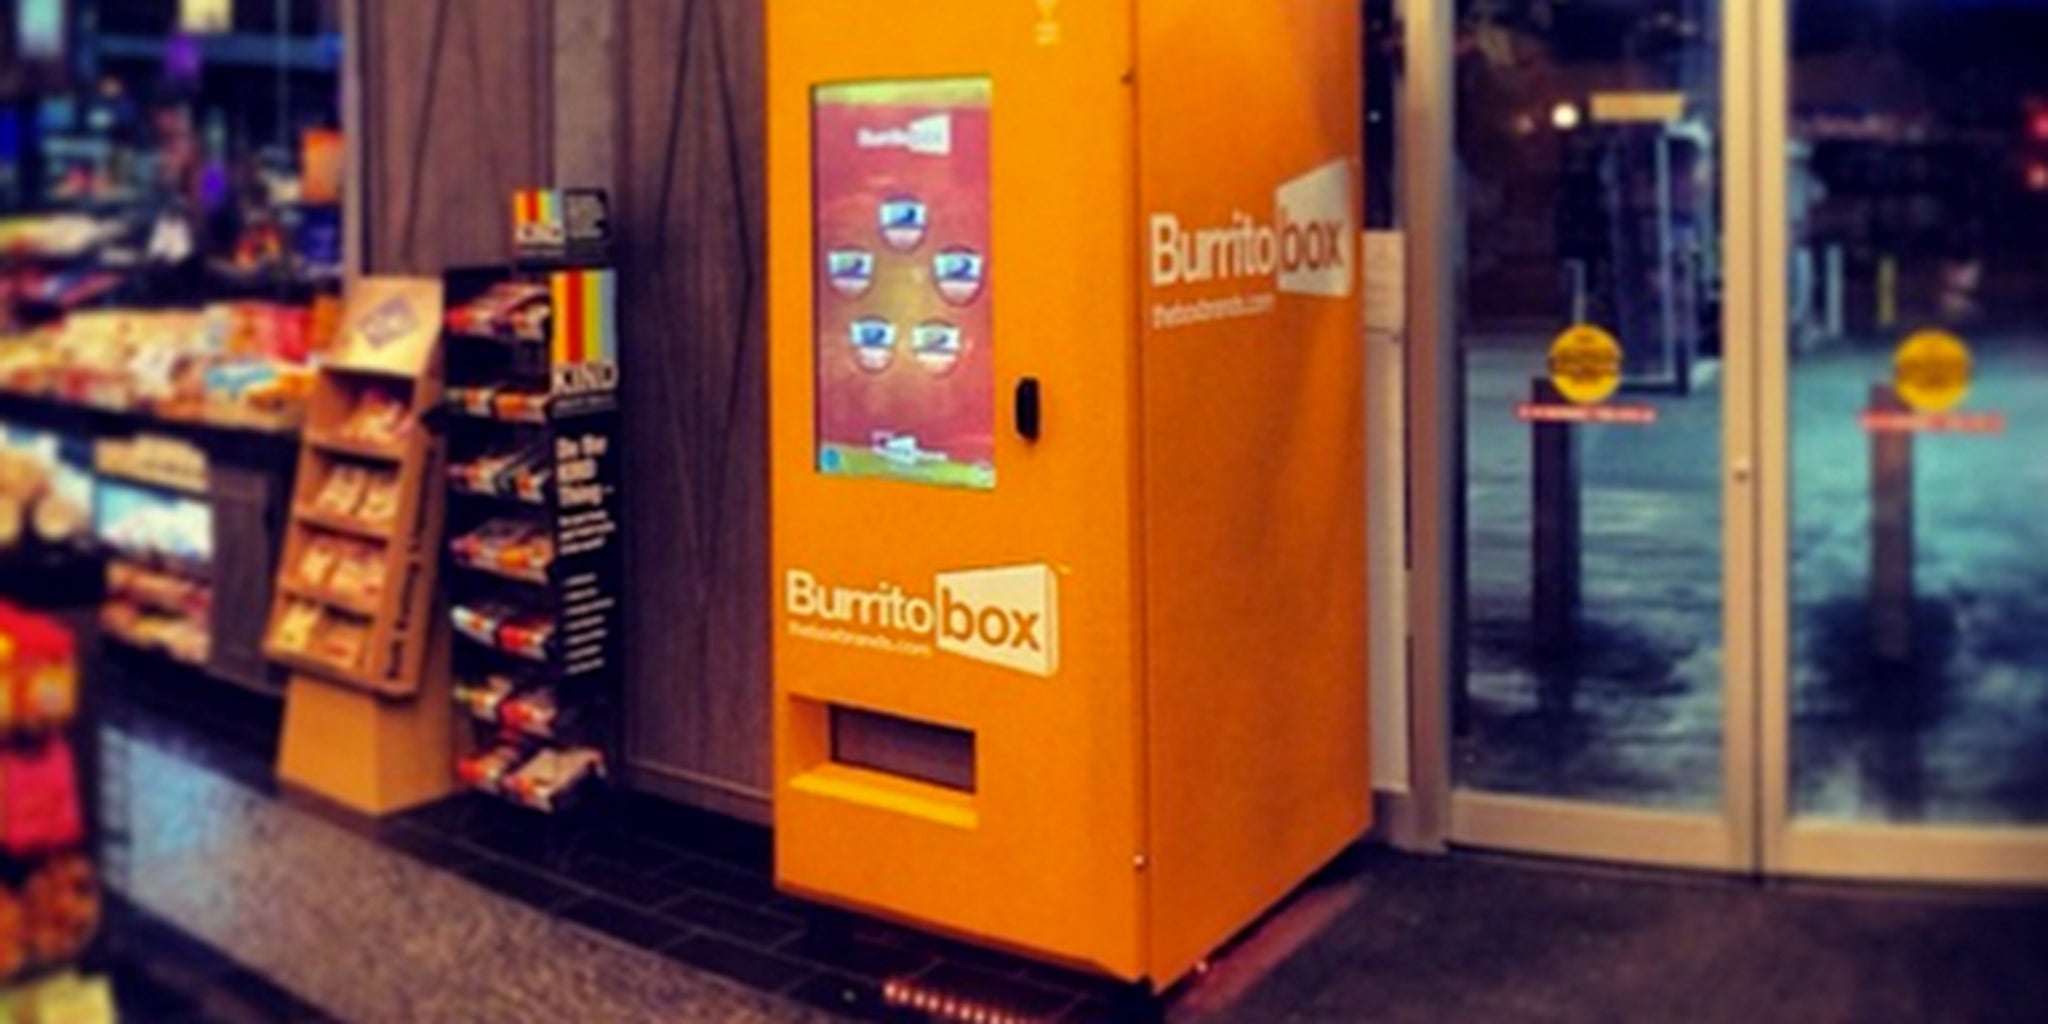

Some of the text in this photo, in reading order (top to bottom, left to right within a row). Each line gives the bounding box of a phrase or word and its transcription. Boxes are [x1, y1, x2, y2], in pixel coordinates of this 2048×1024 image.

[1150, 205, 1344, 286] Burrito box
[551, 363, 618, 398] KIND
[786, 569, 1040, 651] Burrito box
